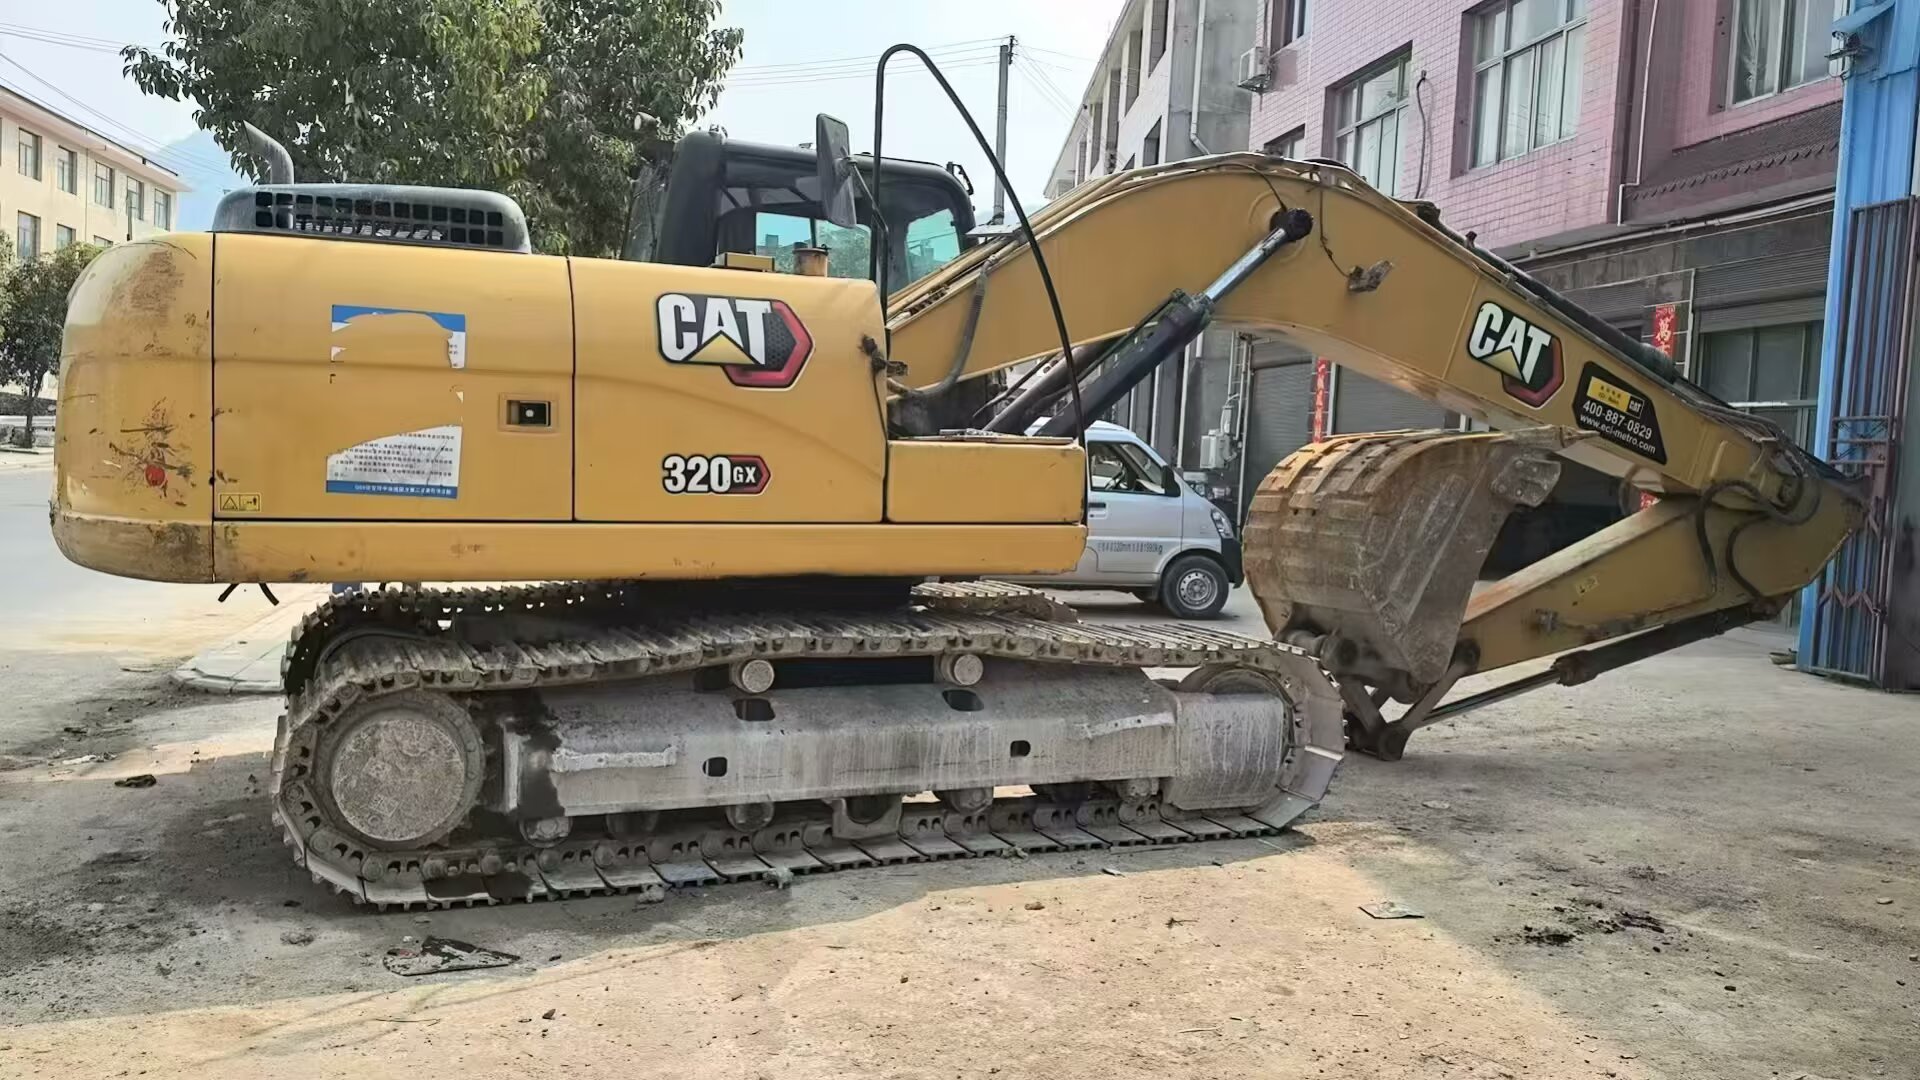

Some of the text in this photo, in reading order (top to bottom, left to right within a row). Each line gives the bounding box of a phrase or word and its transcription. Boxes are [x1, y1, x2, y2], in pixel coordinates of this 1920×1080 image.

[658, 293, 773, 366] CAT
[1469, 302, 1552, 384] CAT
[1582, 400, 1653, 440] 400-887-0829
[1628, 400, 1642, 413] CAT
[1579, 414, 1656, 454] www.eci-metro.com
